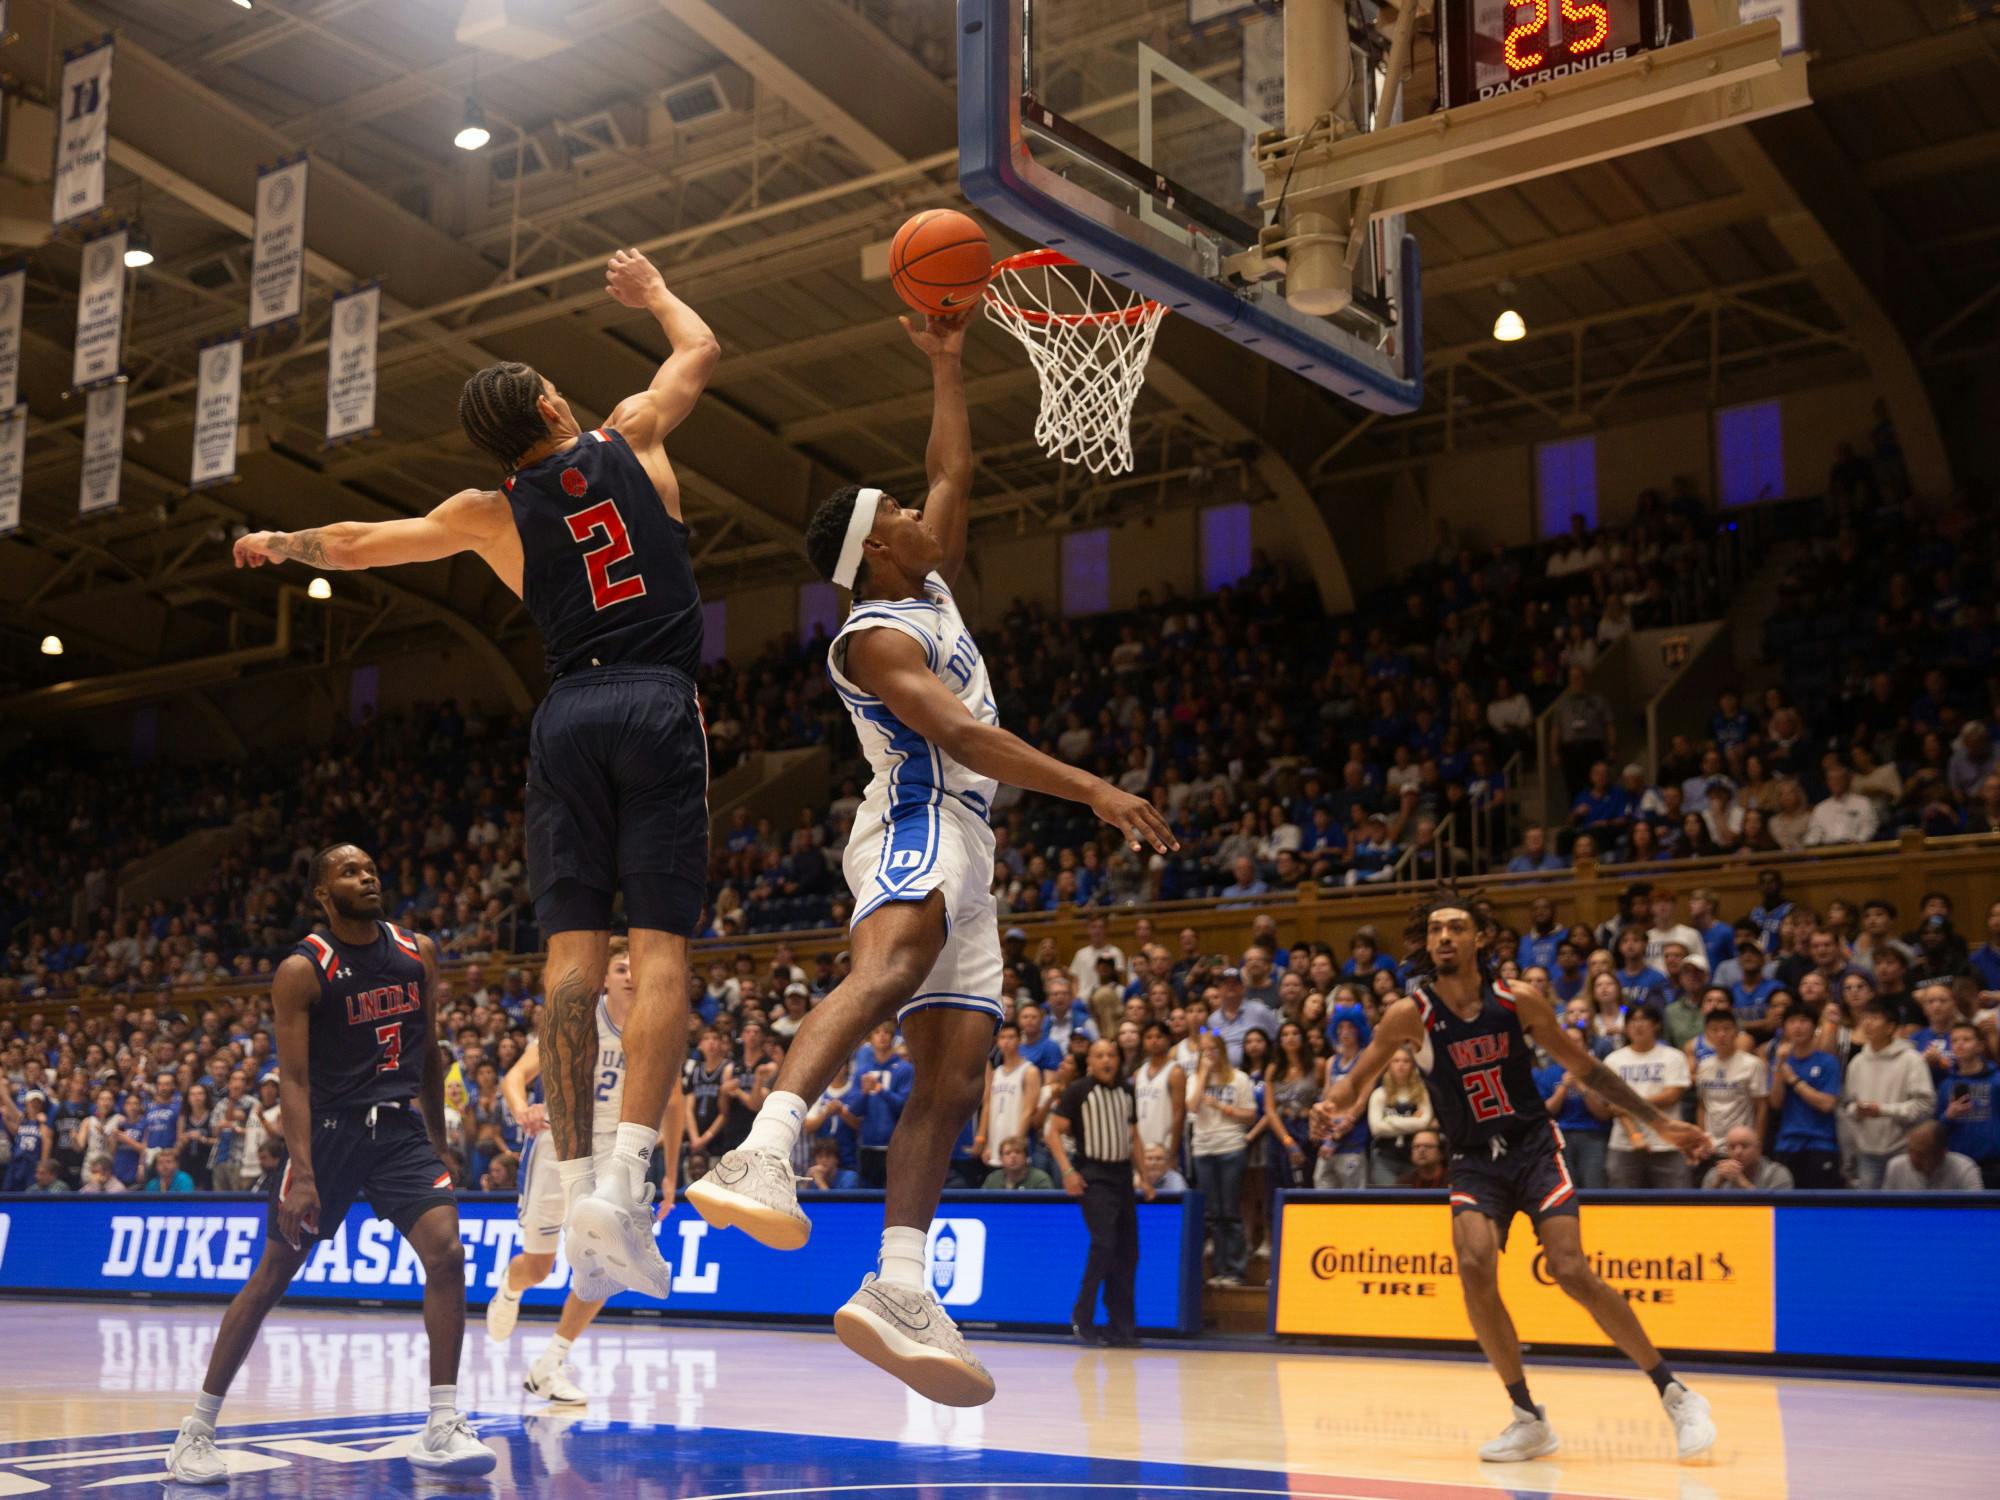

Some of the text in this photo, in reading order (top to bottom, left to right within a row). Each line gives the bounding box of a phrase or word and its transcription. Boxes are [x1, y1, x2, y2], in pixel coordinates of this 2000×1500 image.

[1503, 0, 1608, 71] 25
[1480, 47, 1628, 100] DAKTRONICS
[563, 498, 647, 611] 2
[346, 981, 421, 1025] LINCOLN
[375, 1021, 402, 1075] 3
[1447, 1031, 1510, 1070] LINCOLN
[1462, 1065, 1515, 1123] 21
[101, 1215, 260, 1280] DUKE
[1310, 1245, 1457, 1281] Continenta
[1357, 1280, 1437, 1297] TIRE
